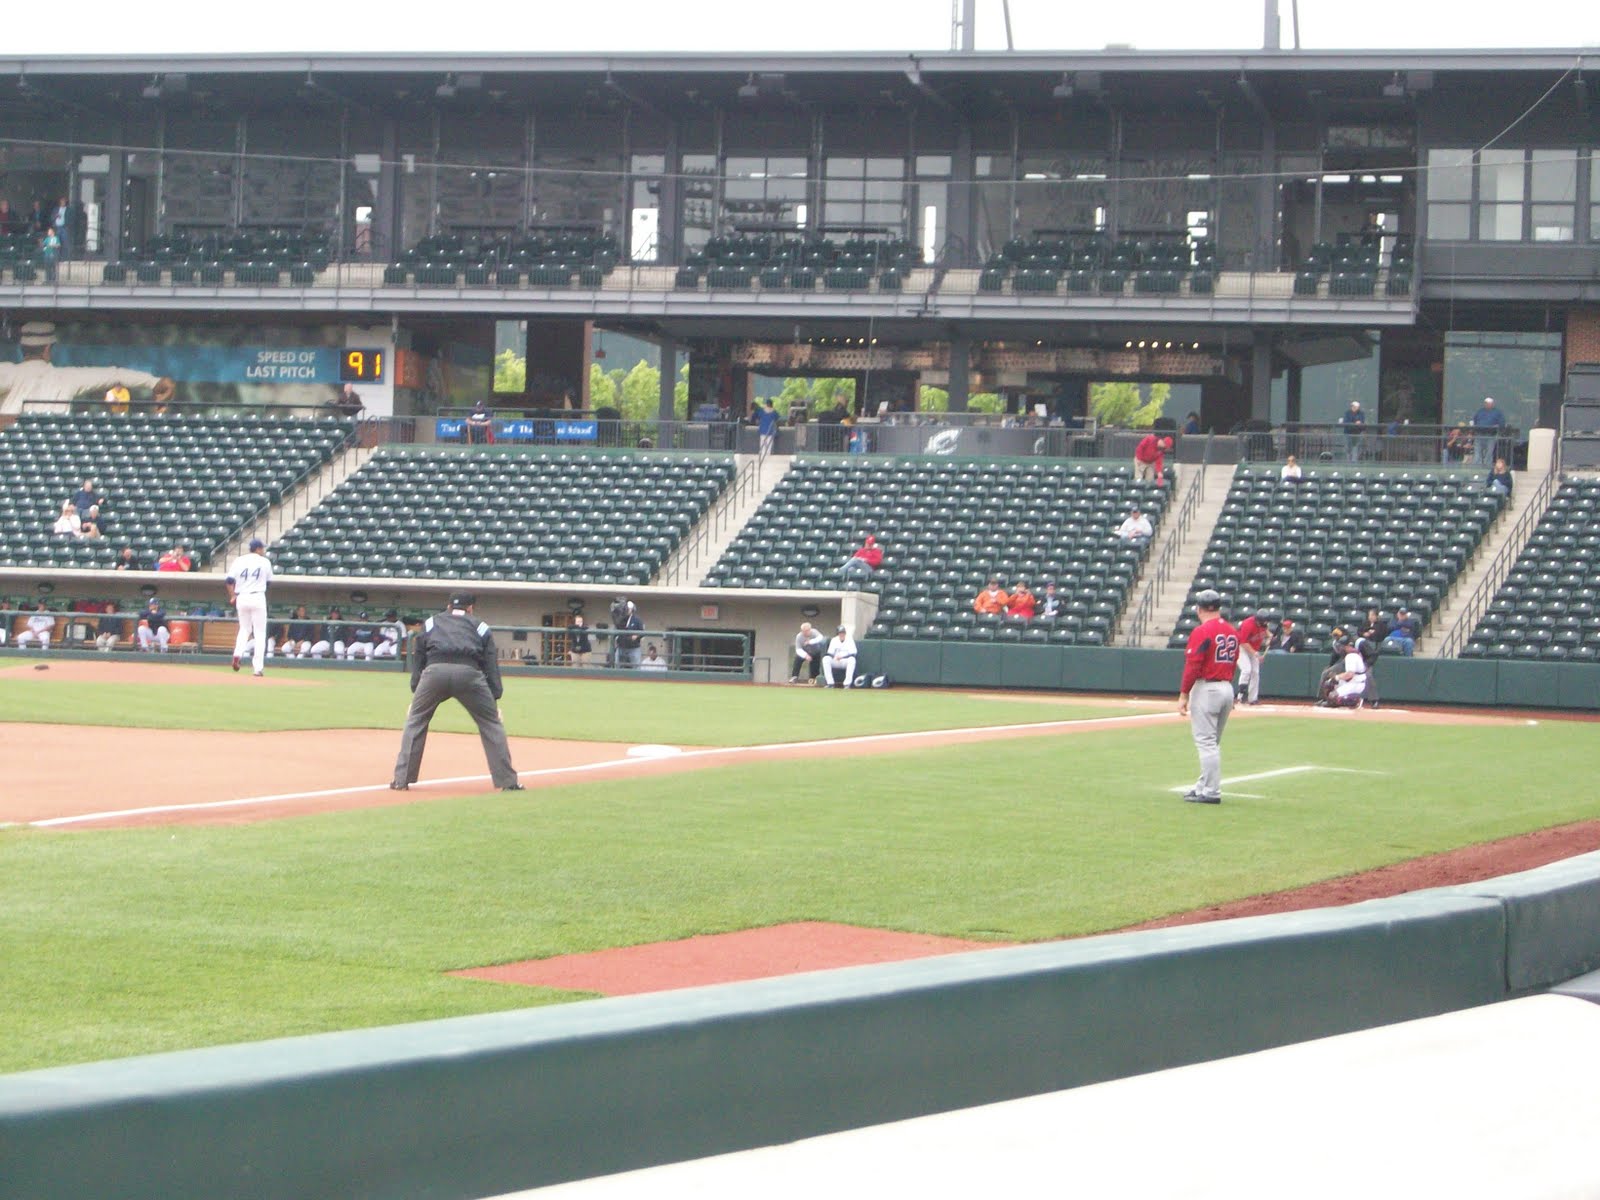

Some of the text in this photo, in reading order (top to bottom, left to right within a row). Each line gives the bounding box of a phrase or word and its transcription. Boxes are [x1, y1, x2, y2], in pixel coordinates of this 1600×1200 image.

[257, 351, 316, 363] SPEED OF
[348, 351, 382, 376] 91
[246, 365, 316, 378] LAST PITCH
[240, 567, 261, 581] 44
[1215, 634, 1238, 663] 22
